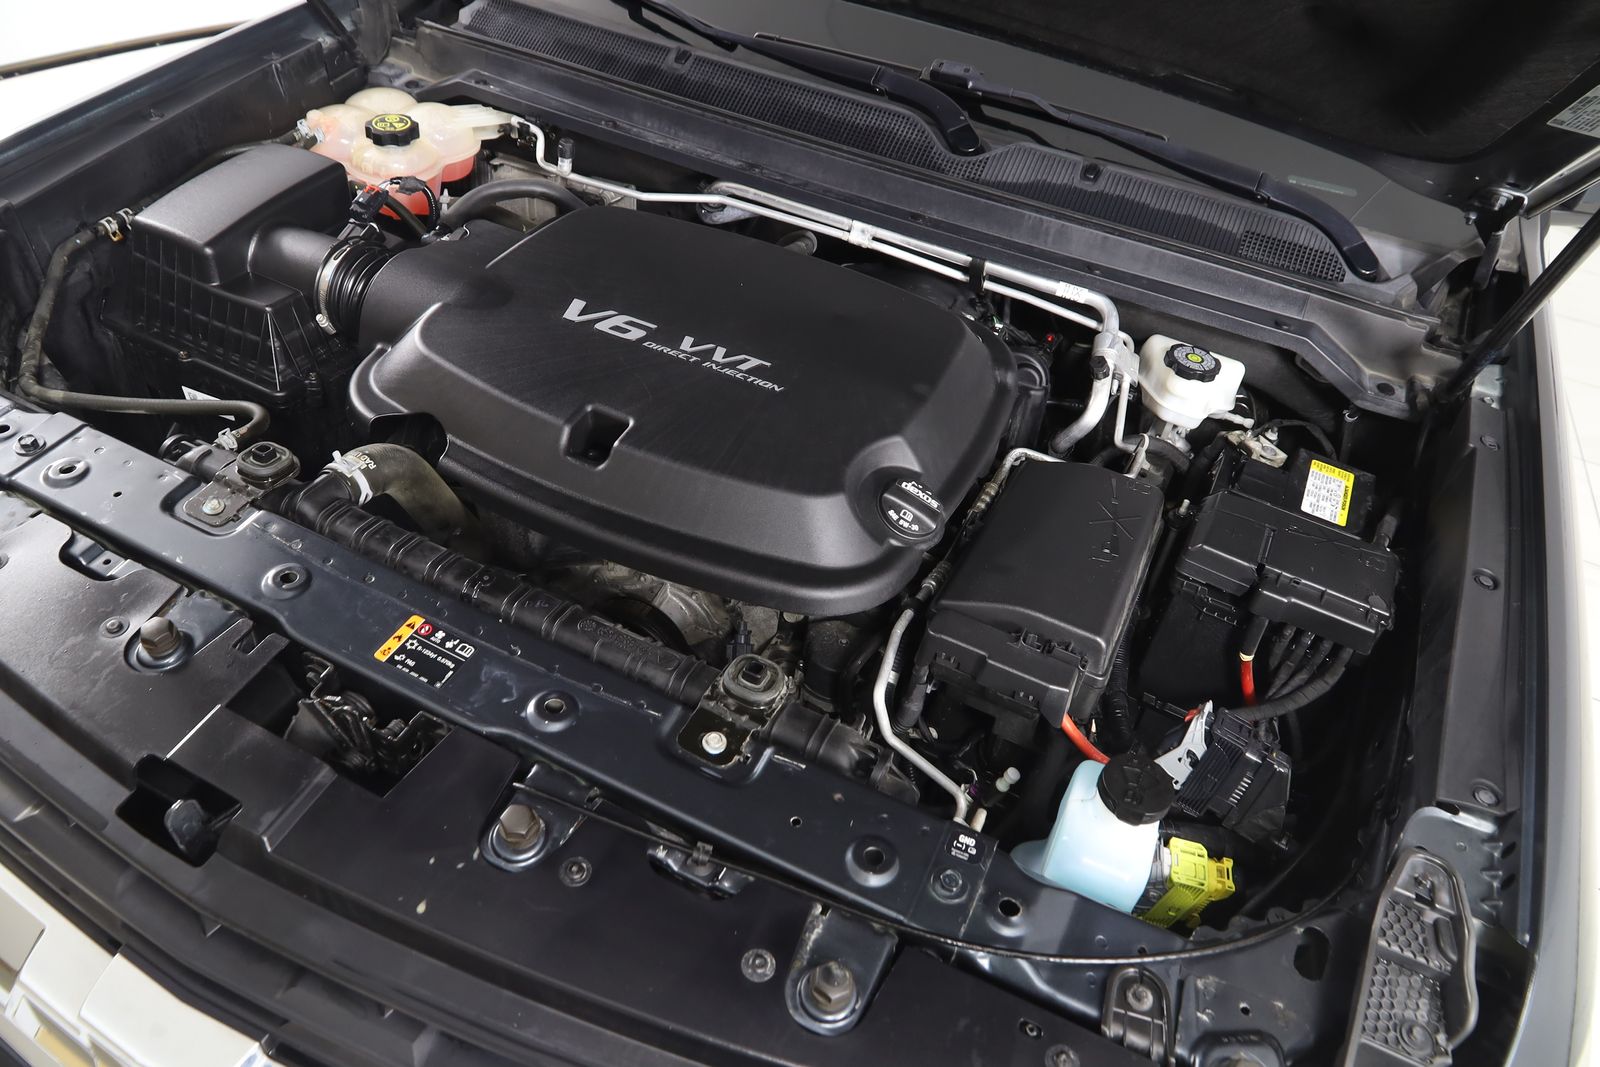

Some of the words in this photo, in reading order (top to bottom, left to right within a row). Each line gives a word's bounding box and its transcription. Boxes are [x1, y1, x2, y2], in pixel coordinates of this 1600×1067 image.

[563, 298, 658, 341] V6
[679, 335, 772, 371] VVT
[642, 341, 701, 363] DIRECT
[702, 361, 784, 392] INJECTION
[901, 481, 941, 508] dexos
[958, 834, 976, 847] GND
